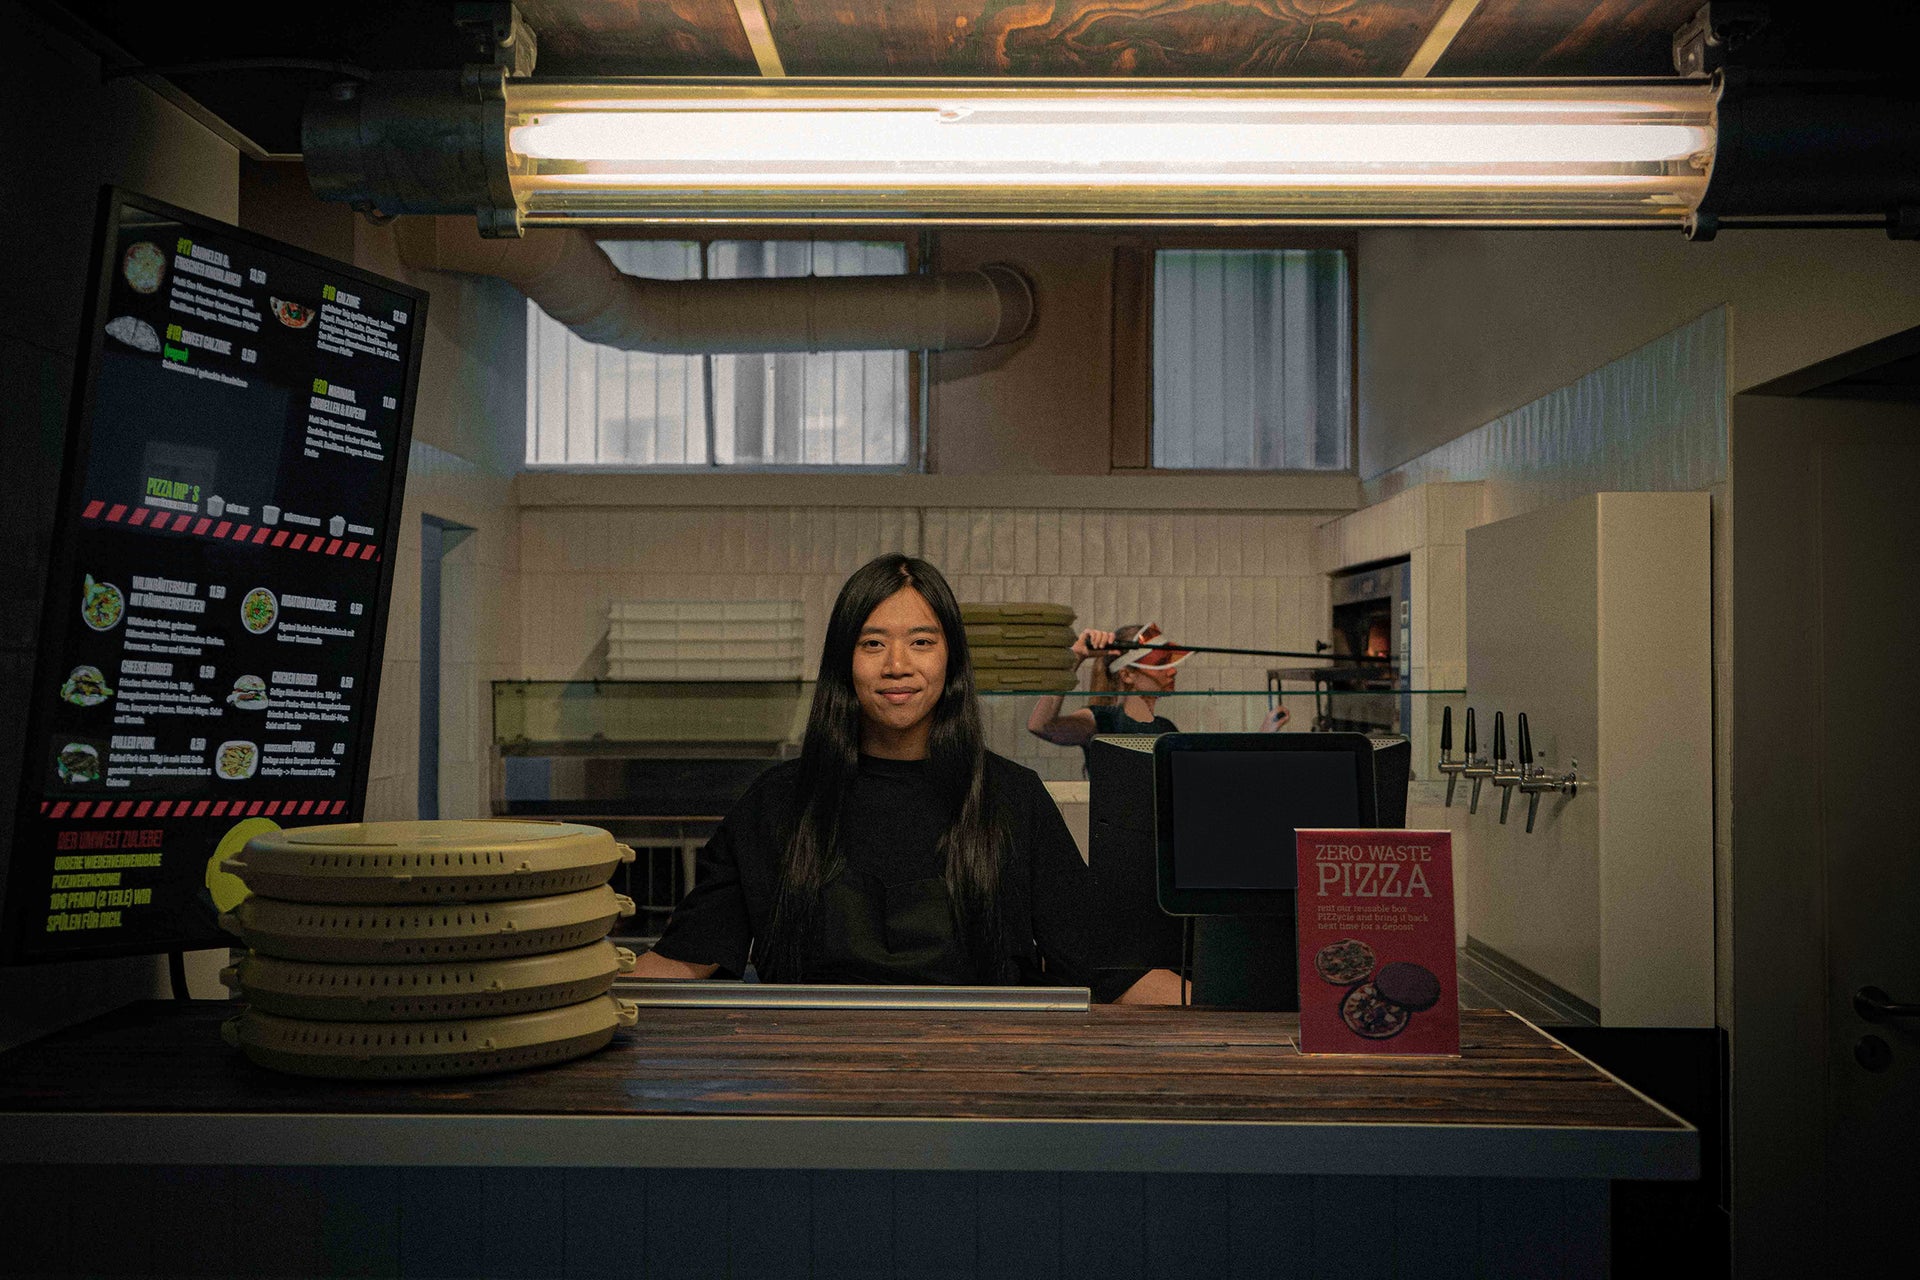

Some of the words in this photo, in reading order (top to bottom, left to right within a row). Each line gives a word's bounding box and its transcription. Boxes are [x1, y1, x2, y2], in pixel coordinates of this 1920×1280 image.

[147, 477, 173, 498] PIZZA
[1315, 844, 1363, 861] ZERO
[1368, 844, 1432, 862] WASTE
[1315, 862, 1433, 898] PIZZA
